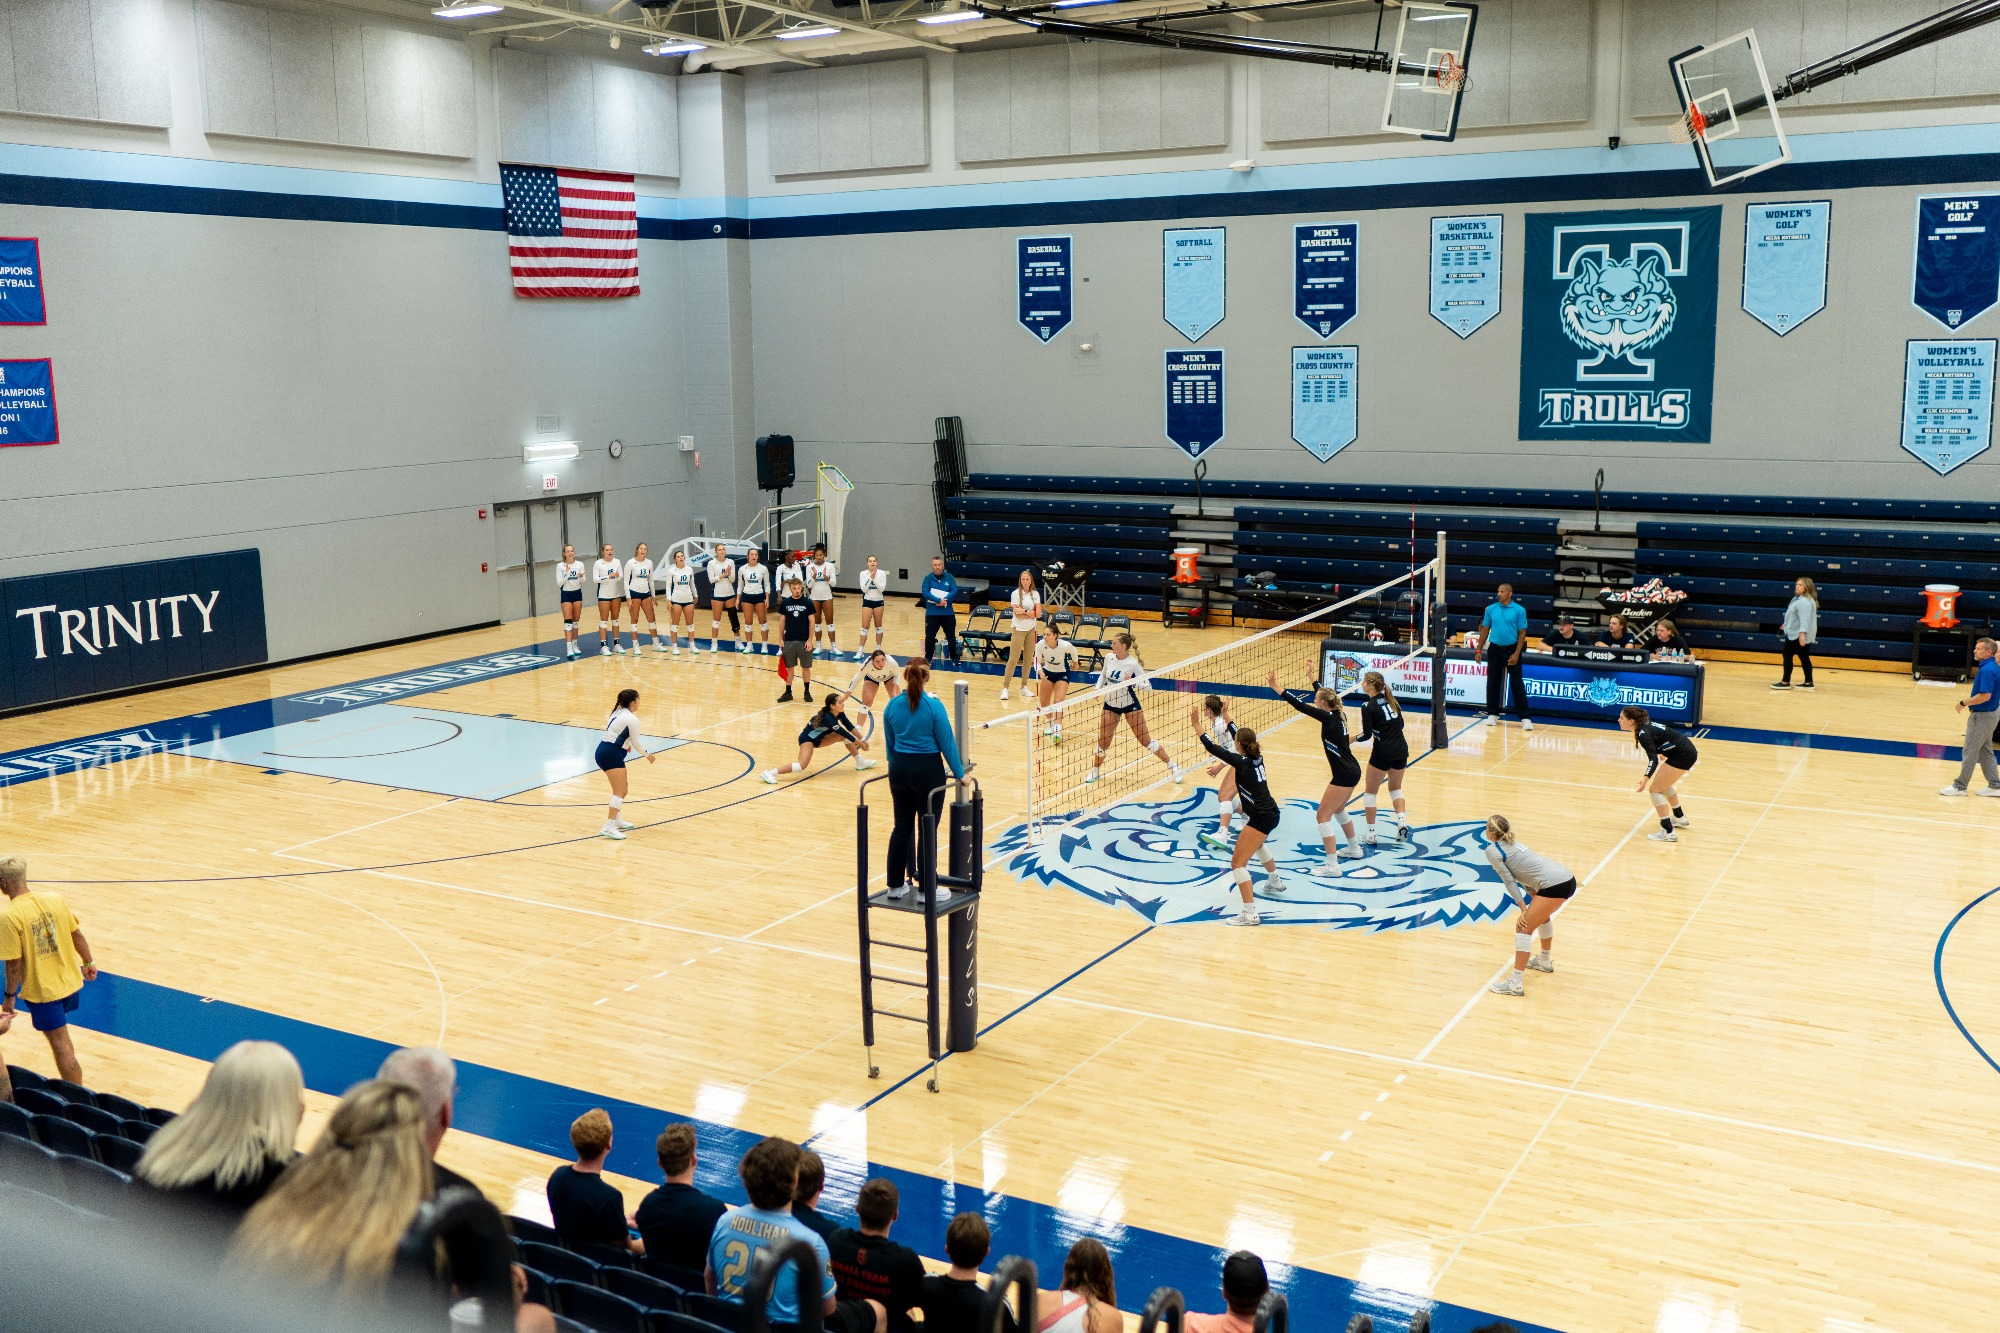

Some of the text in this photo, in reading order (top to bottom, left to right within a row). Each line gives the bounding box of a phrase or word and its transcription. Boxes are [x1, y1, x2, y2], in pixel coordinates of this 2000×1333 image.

[1944, 201, 1979, 210] MEN'S
[1765, 209, 1811, 218] WOMEN'S
[1948, 212, 1974, 222] GOLF
[1447, 222, 1486, 230] WOMEN'S
[1314, 228, 1339, 237] MEN'S
[1440, 232, 1493, 240] BASKETBALL
[1176, 238, 1212, 246] SOFTBALL
[1300, 238, 1352, 247] BASKETBALL
[1027, 246, 1062, 254] BASEBALL
[1927, 347, 1976, 355] WOMEN'S
[1918, 358, 1984, 366] VOLLEYBALL
[1543, 392, 1686, 424] TROLLS
[1180, 558, 1189, 568] G
[1939, 597, 1952, 611] G
[1621, 608, 1652, 616] Baden
[16, 590, 220, 659] TRINITY
[1593, 652, 1608, 660] POSS
[1372, 657, 1488, 677] SERVING THE UTHLAND
[303, 653, 552, 702] TROLLS
[1110, 670, 1121, 679] 14
[1404, 674, 1427, 682] SINCE
[1392, 682, 1418, 694] Savings
[1421, 684, 1432, 694] wit
[1621, 687, 1686, 707] TROLLS
[730, 1215, 790, 1240] HOULIHAN
